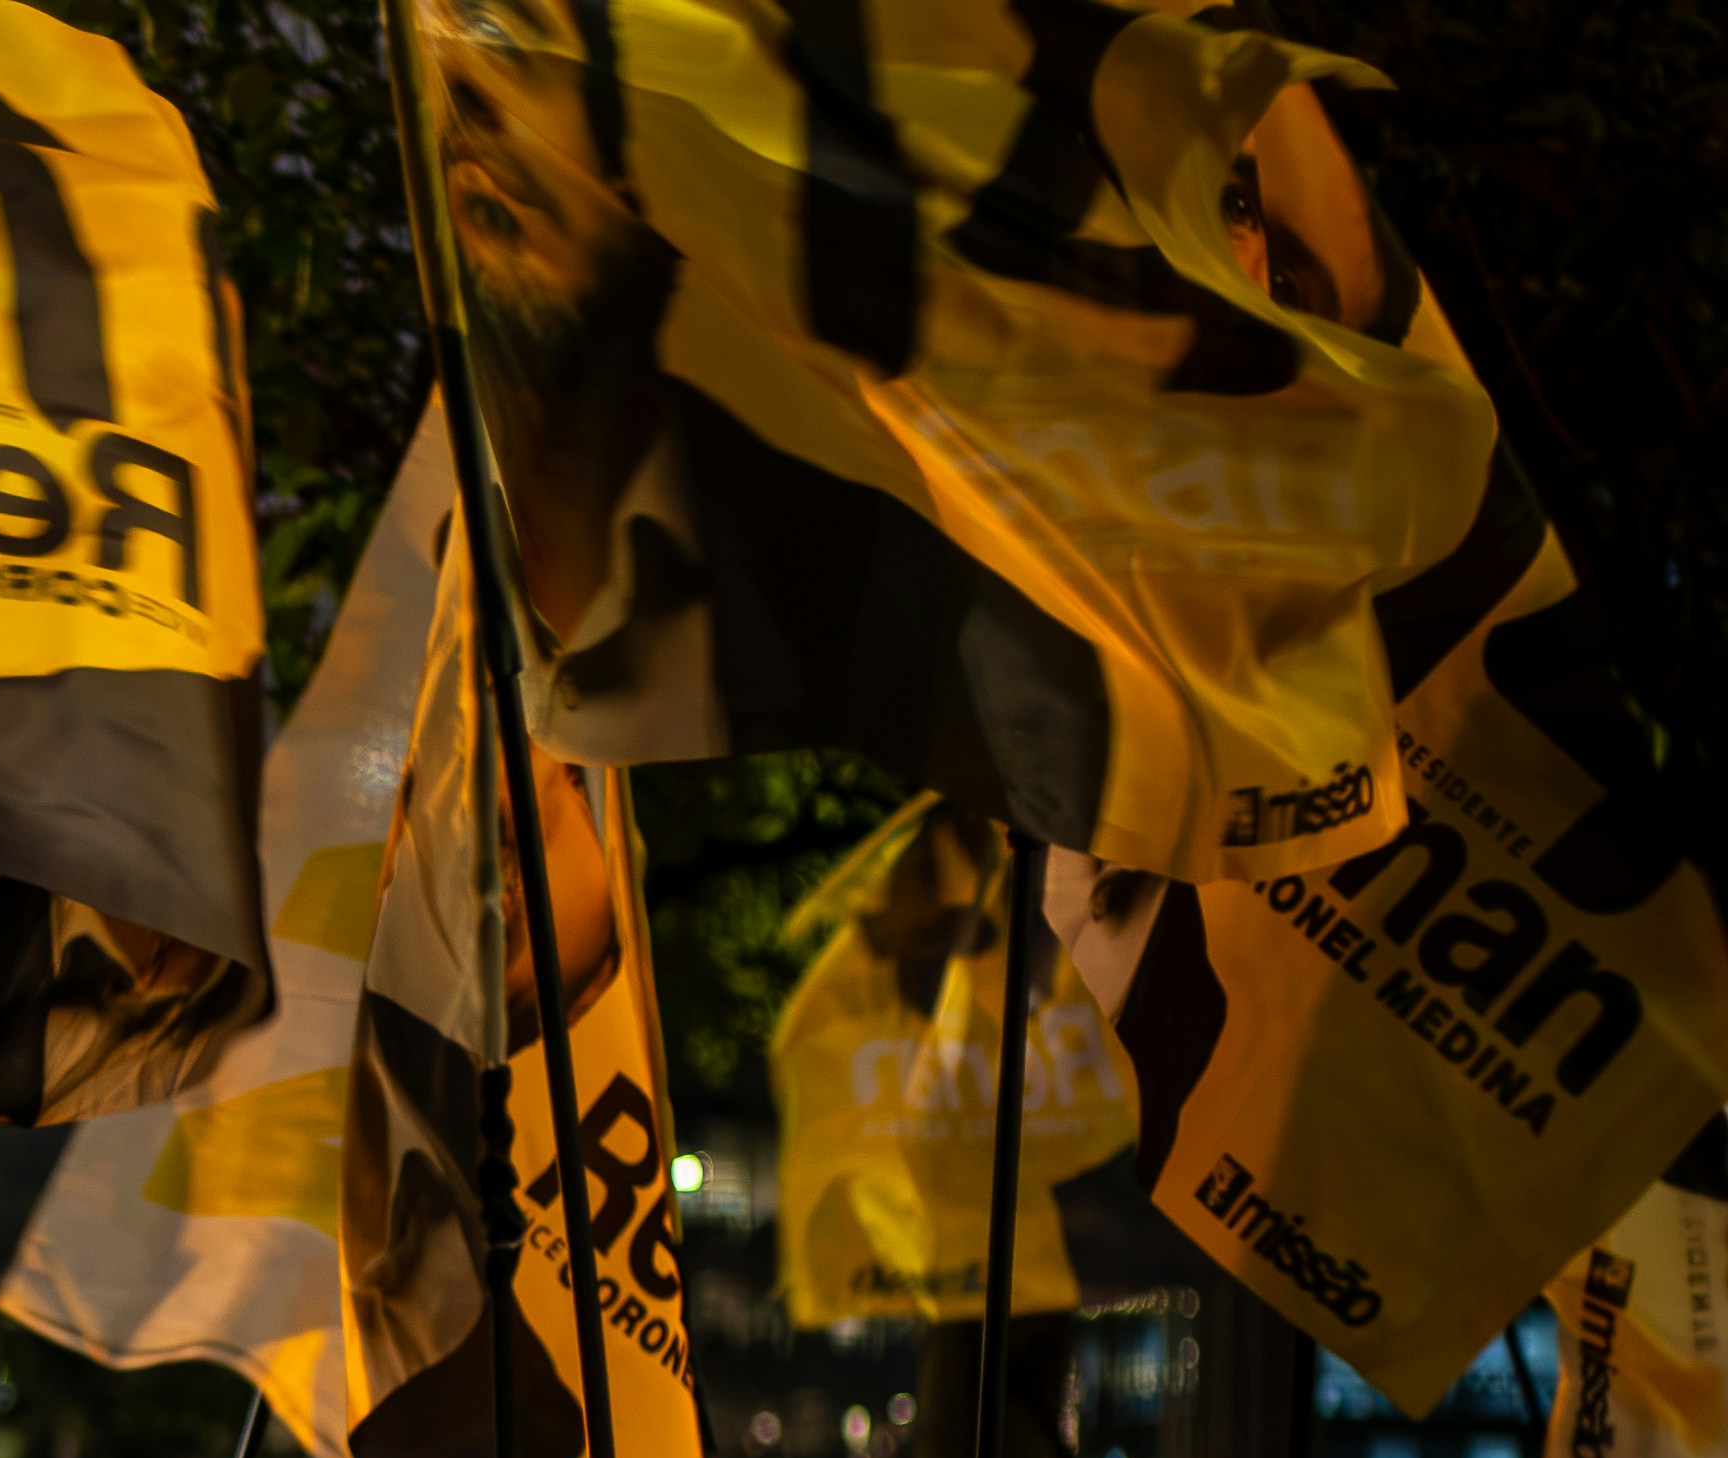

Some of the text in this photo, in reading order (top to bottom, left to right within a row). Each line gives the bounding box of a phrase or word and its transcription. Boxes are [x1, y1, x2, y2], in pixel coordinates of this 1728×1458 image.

[1253, 873, 1558, 1139] ONEL MEDINA
[1328, 796, 1642, 1099] nan
[1227, 1192, 1382, 1328] missão
